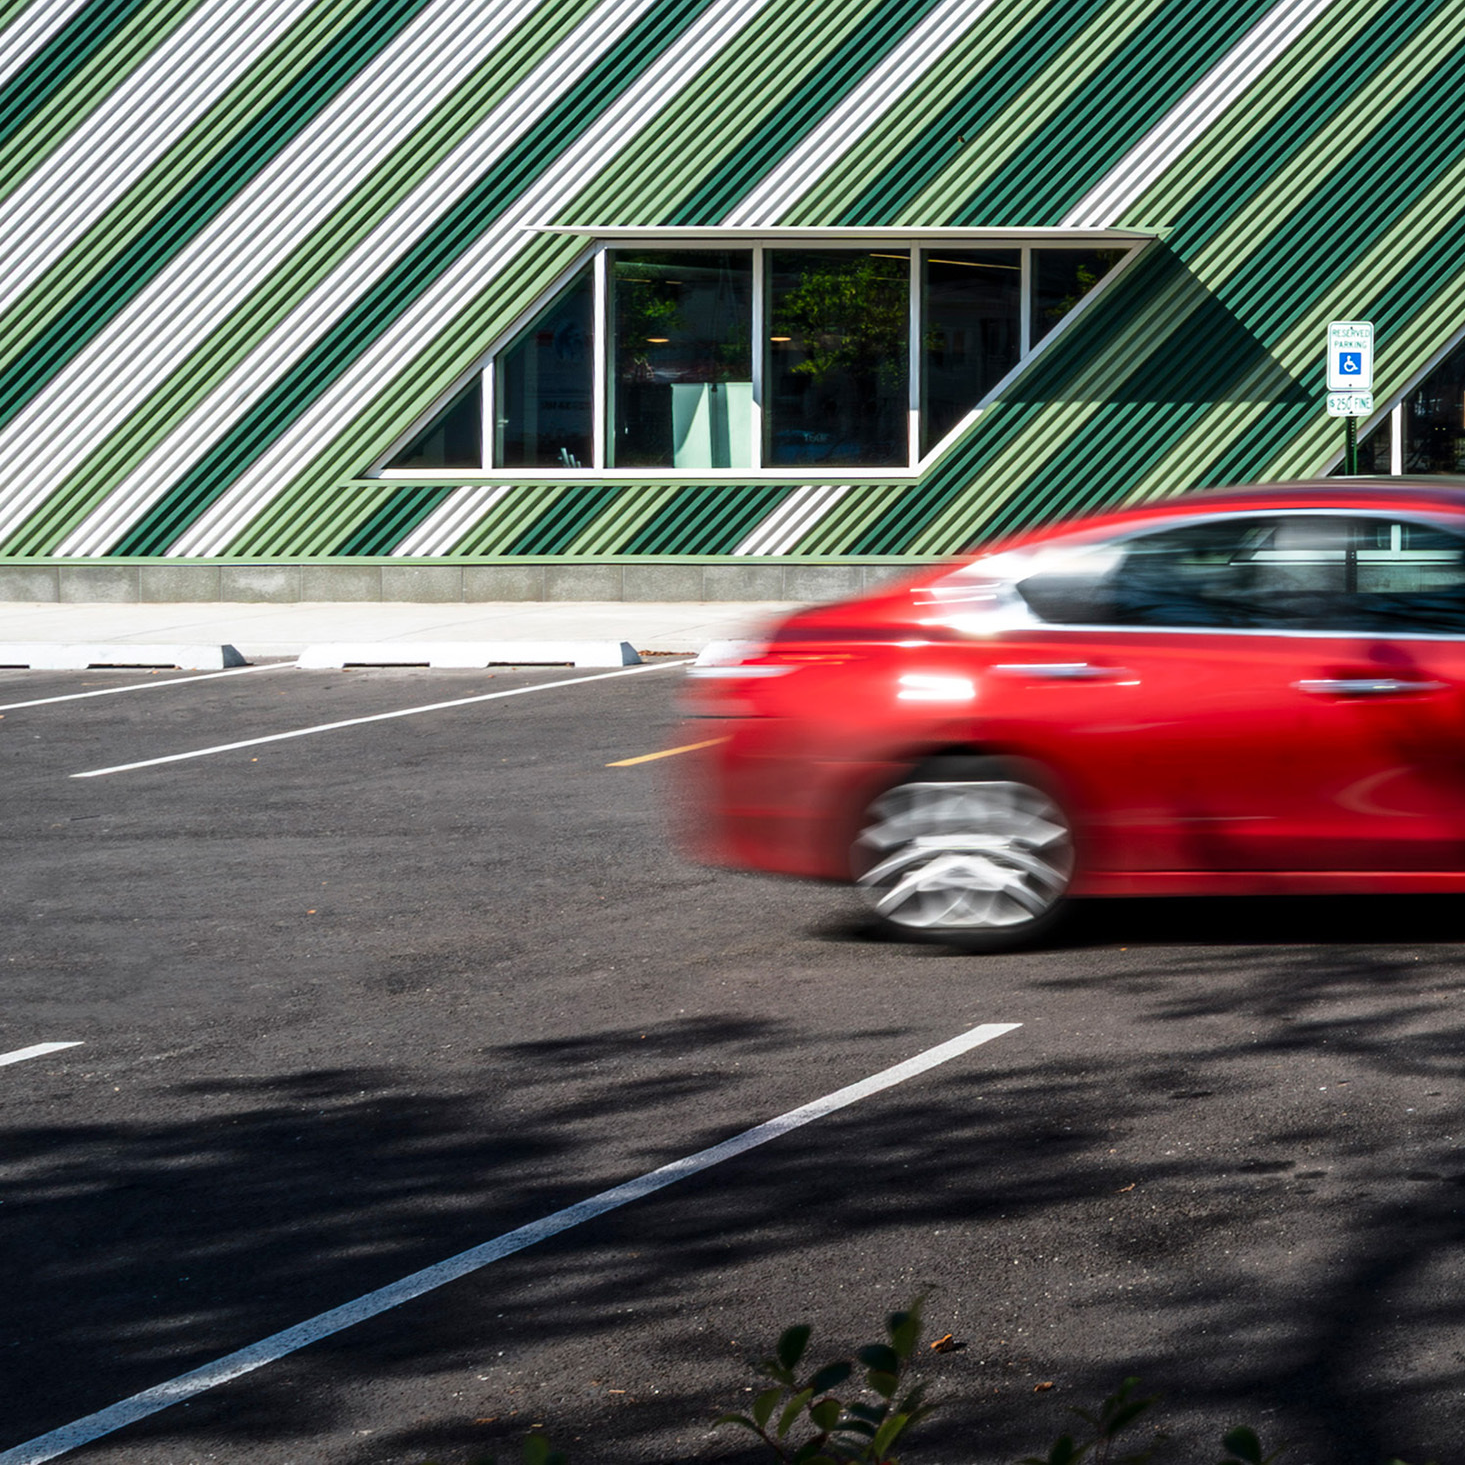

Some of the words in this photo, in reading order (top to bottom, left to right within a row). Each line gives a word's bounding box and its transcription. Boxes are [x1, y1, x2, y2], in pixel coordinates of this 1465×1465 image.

[1332, 329, 1369, 337] RESERVED
[1330, 398, 1351, 410] $250
[1355, 397, 1371, 409] FINE
